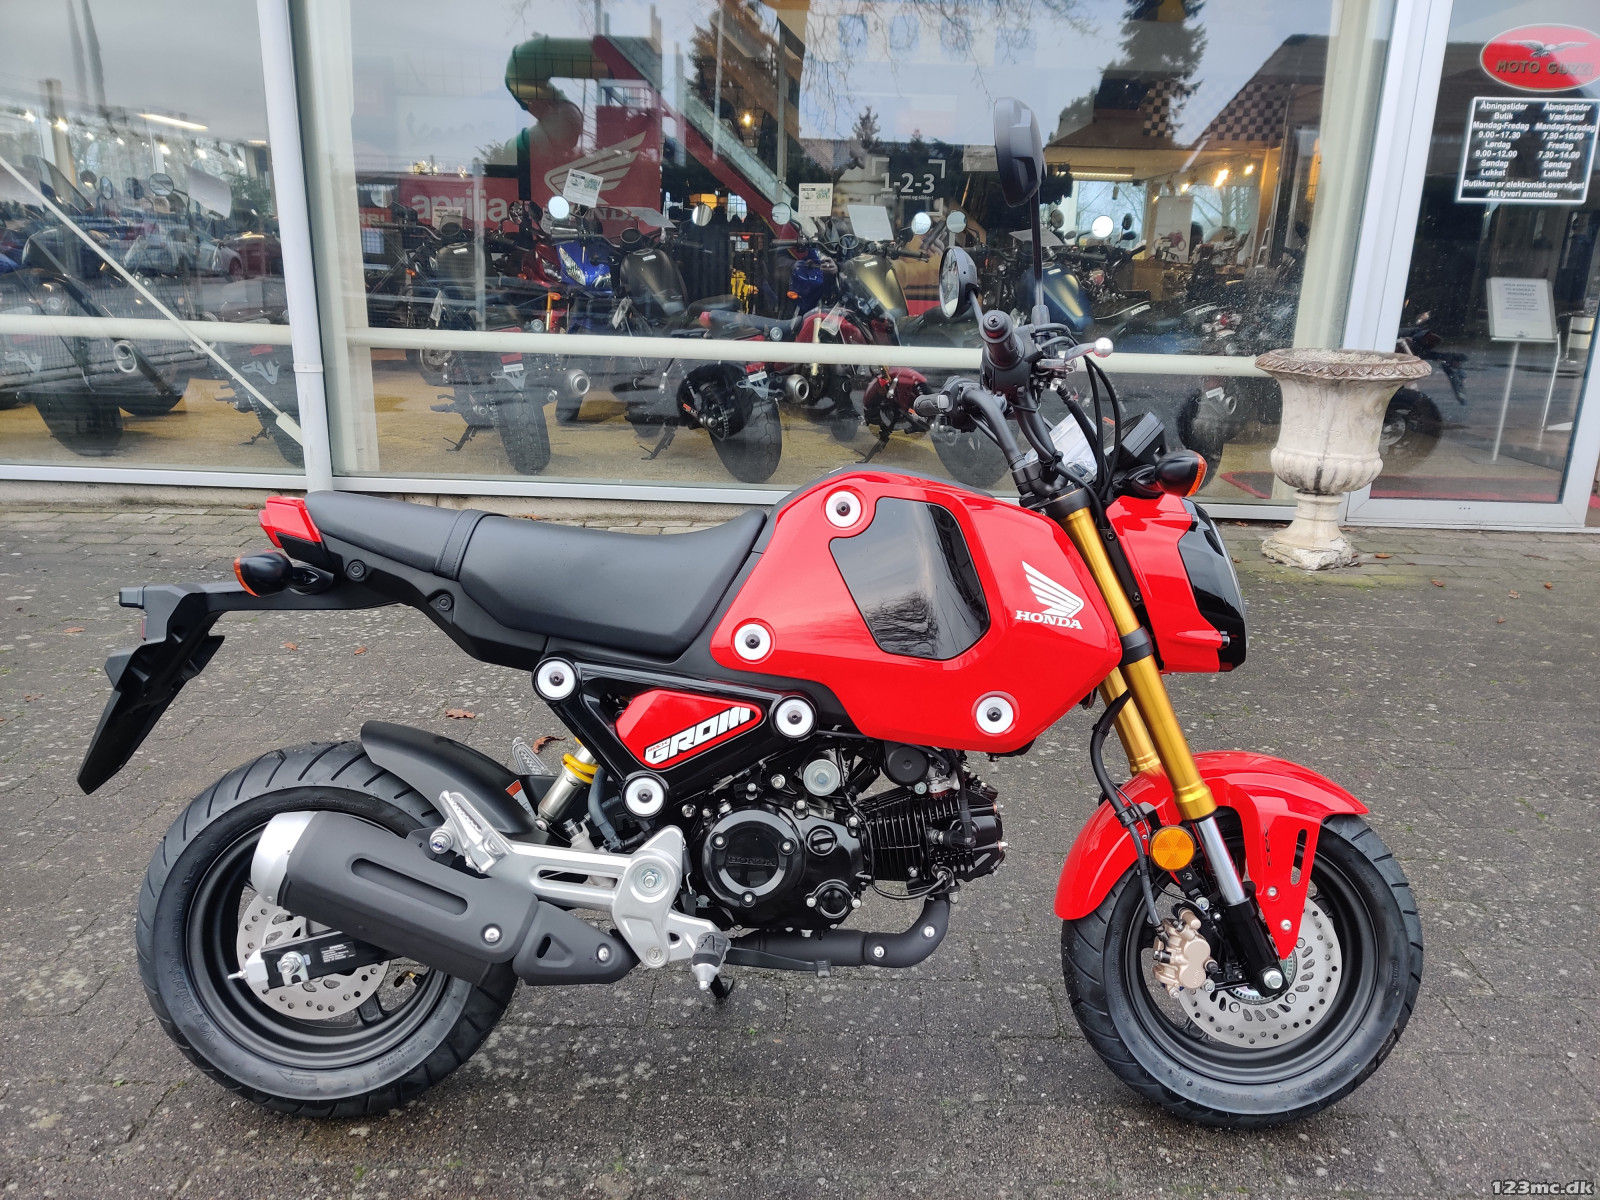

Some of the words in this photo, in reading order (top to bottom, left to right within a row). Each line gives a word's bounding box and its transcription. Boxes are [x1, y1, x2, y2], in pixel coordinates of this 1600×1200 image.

[1496, 60, 1540, 73] MOTO
[1547, 62, 1593, 76] GUZZI
[1480, 101, 1528, 111] Åbningstider
[1544, 102, 1591, 112] Åbningstider
[1485, 141, 1511, 149] Lørdag
[1548, 142, 1574, 150] Fredag
[1480, 160, 1508, 168] Søndag
[1544, 160, 1572, 168] Søndag
[880, 172, 934, 194] 1-2-3
[1506, 180, 1547, 188] elektronisk
[1548, 181, 1584, 190] overvåget
[1500, 190, 1520, 198] tyveri
[411, 189, 507, 222] aprilia
[1015, 610, 1083, 630] HONDA
[644, 706, 750, 764] GROM
